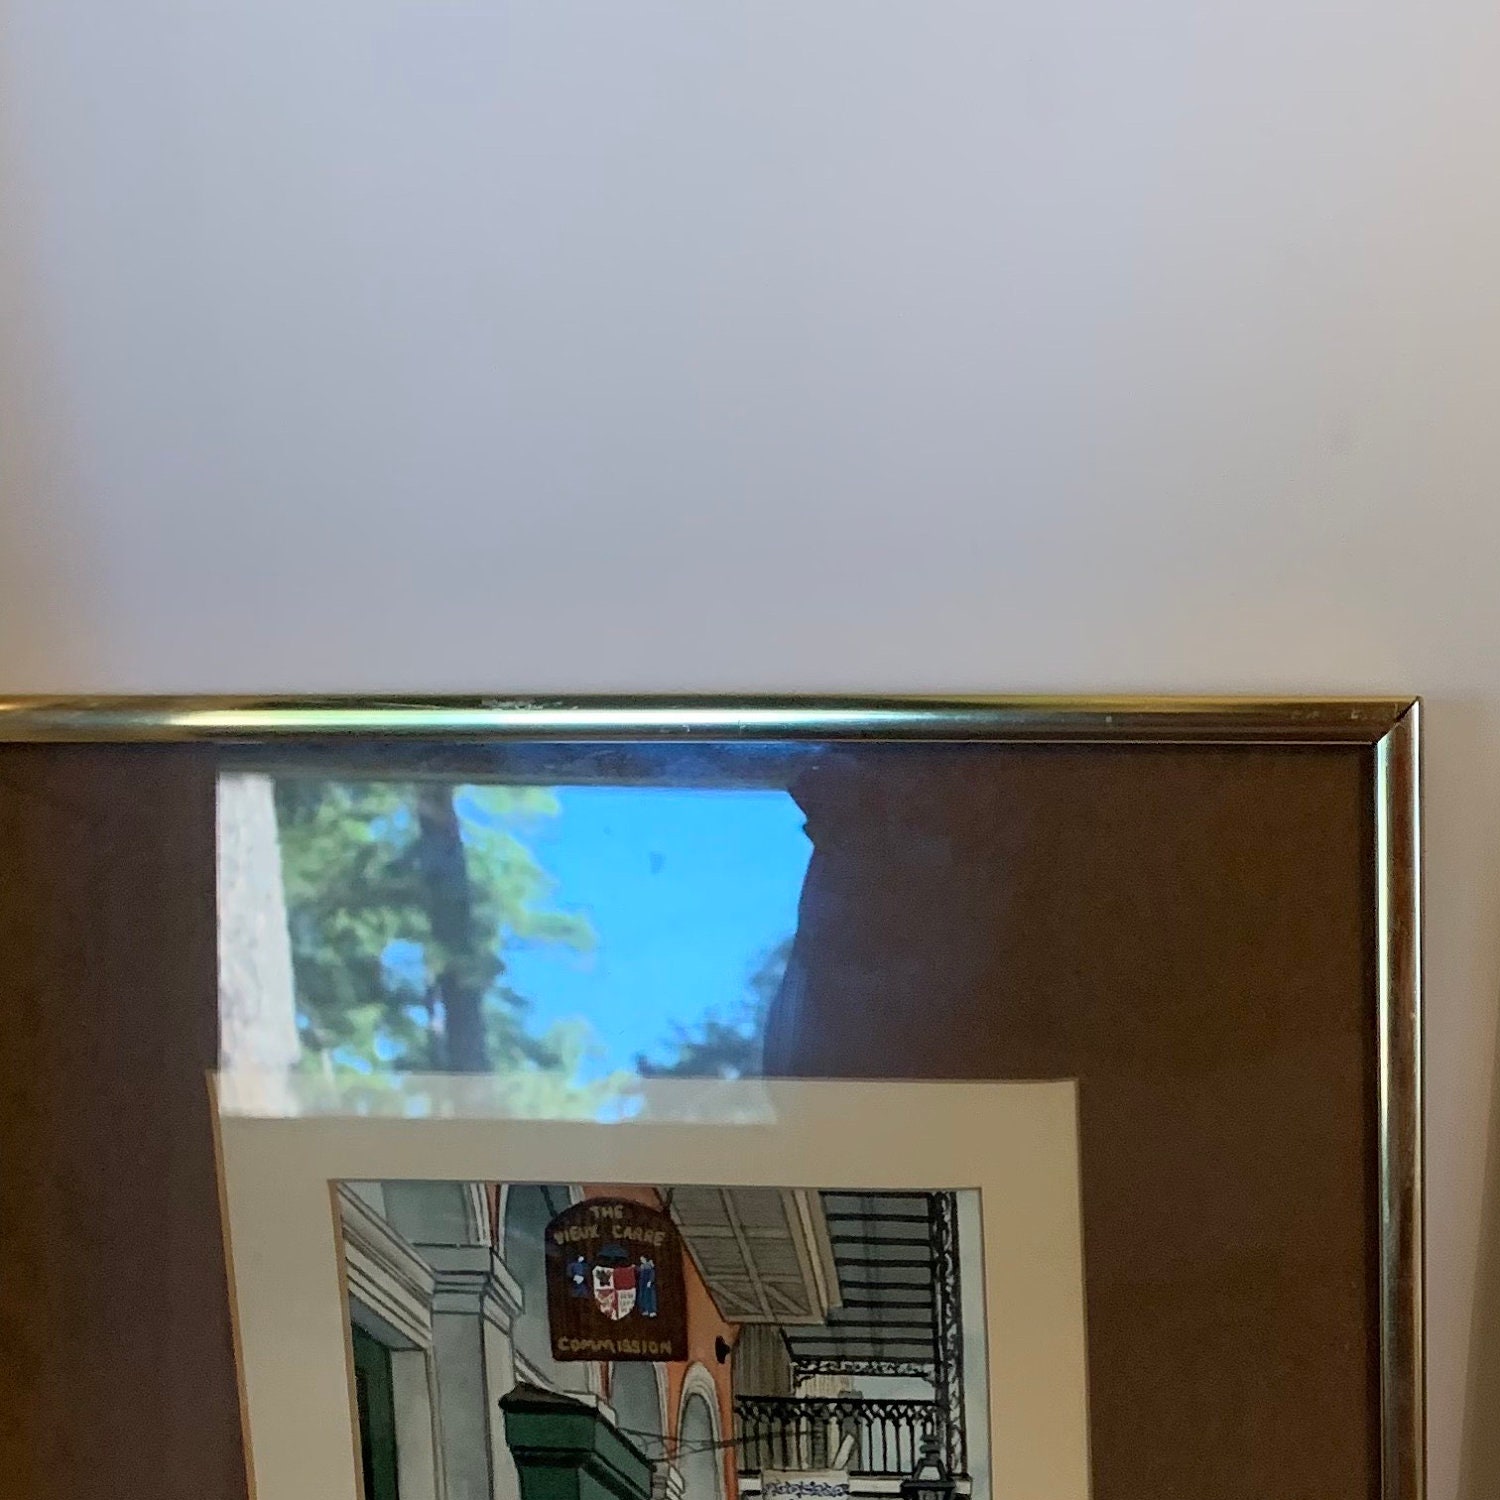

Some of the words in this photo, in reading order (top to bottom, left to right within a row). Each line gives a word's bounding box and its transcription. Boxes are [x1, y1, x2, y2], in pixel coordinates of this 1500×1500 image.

[590, 1205, 624, 1219] THE
[554, 1224, 600, 1245] VIEUX
[557, 1336, 672, 1354] COMMISSION
